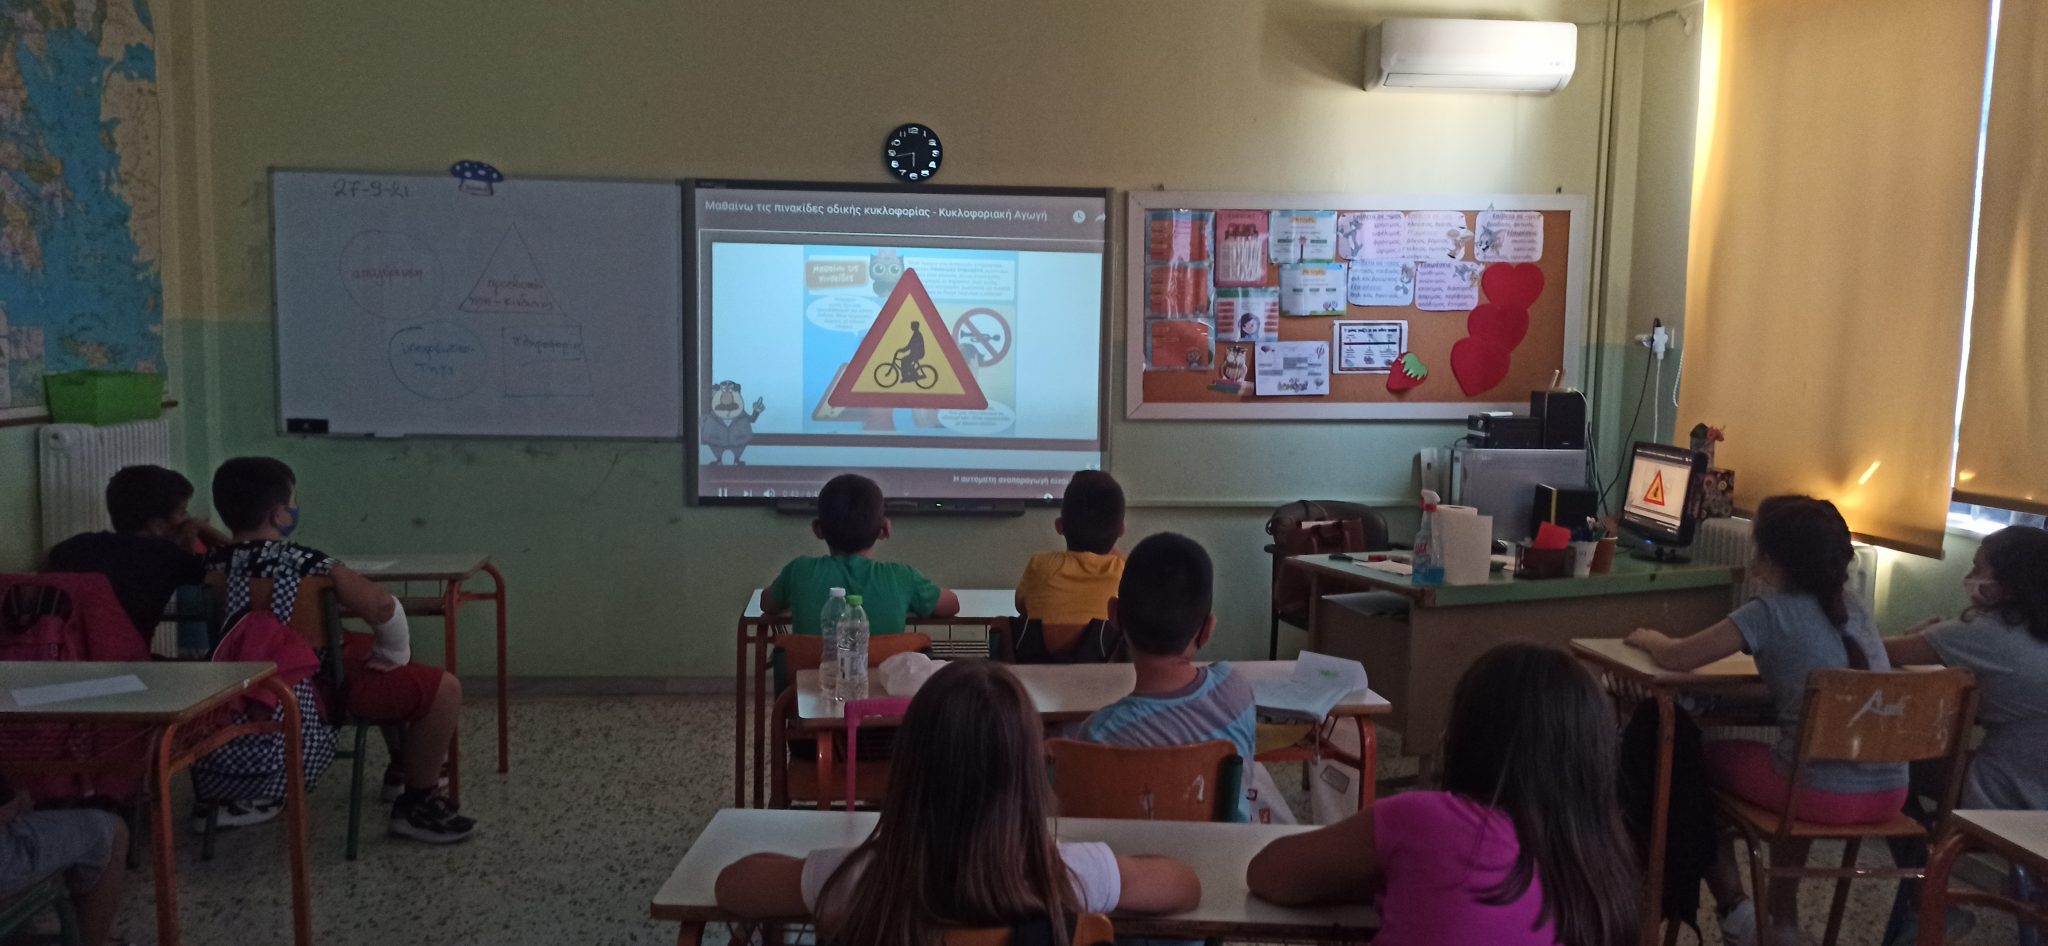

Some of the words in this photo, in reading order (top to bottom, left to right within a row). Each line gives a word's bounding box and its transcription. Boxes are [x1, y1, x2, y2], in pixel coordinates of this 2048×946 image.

[333, 178, 409, 199] 27-9-21
[705, 200, 754, 212] Μαθαίνω
[756, 202, 772, 213] τις
[774, 202, 824, 214] πινακίδες
[827, 204, 861, 216] οδικής
[864, 206, 931, 218] κυκλοφορίας
[938, 208, 1012, 220] Κυκλοφοριακή
[1013, 210, 1048, 222] Αγωγή
